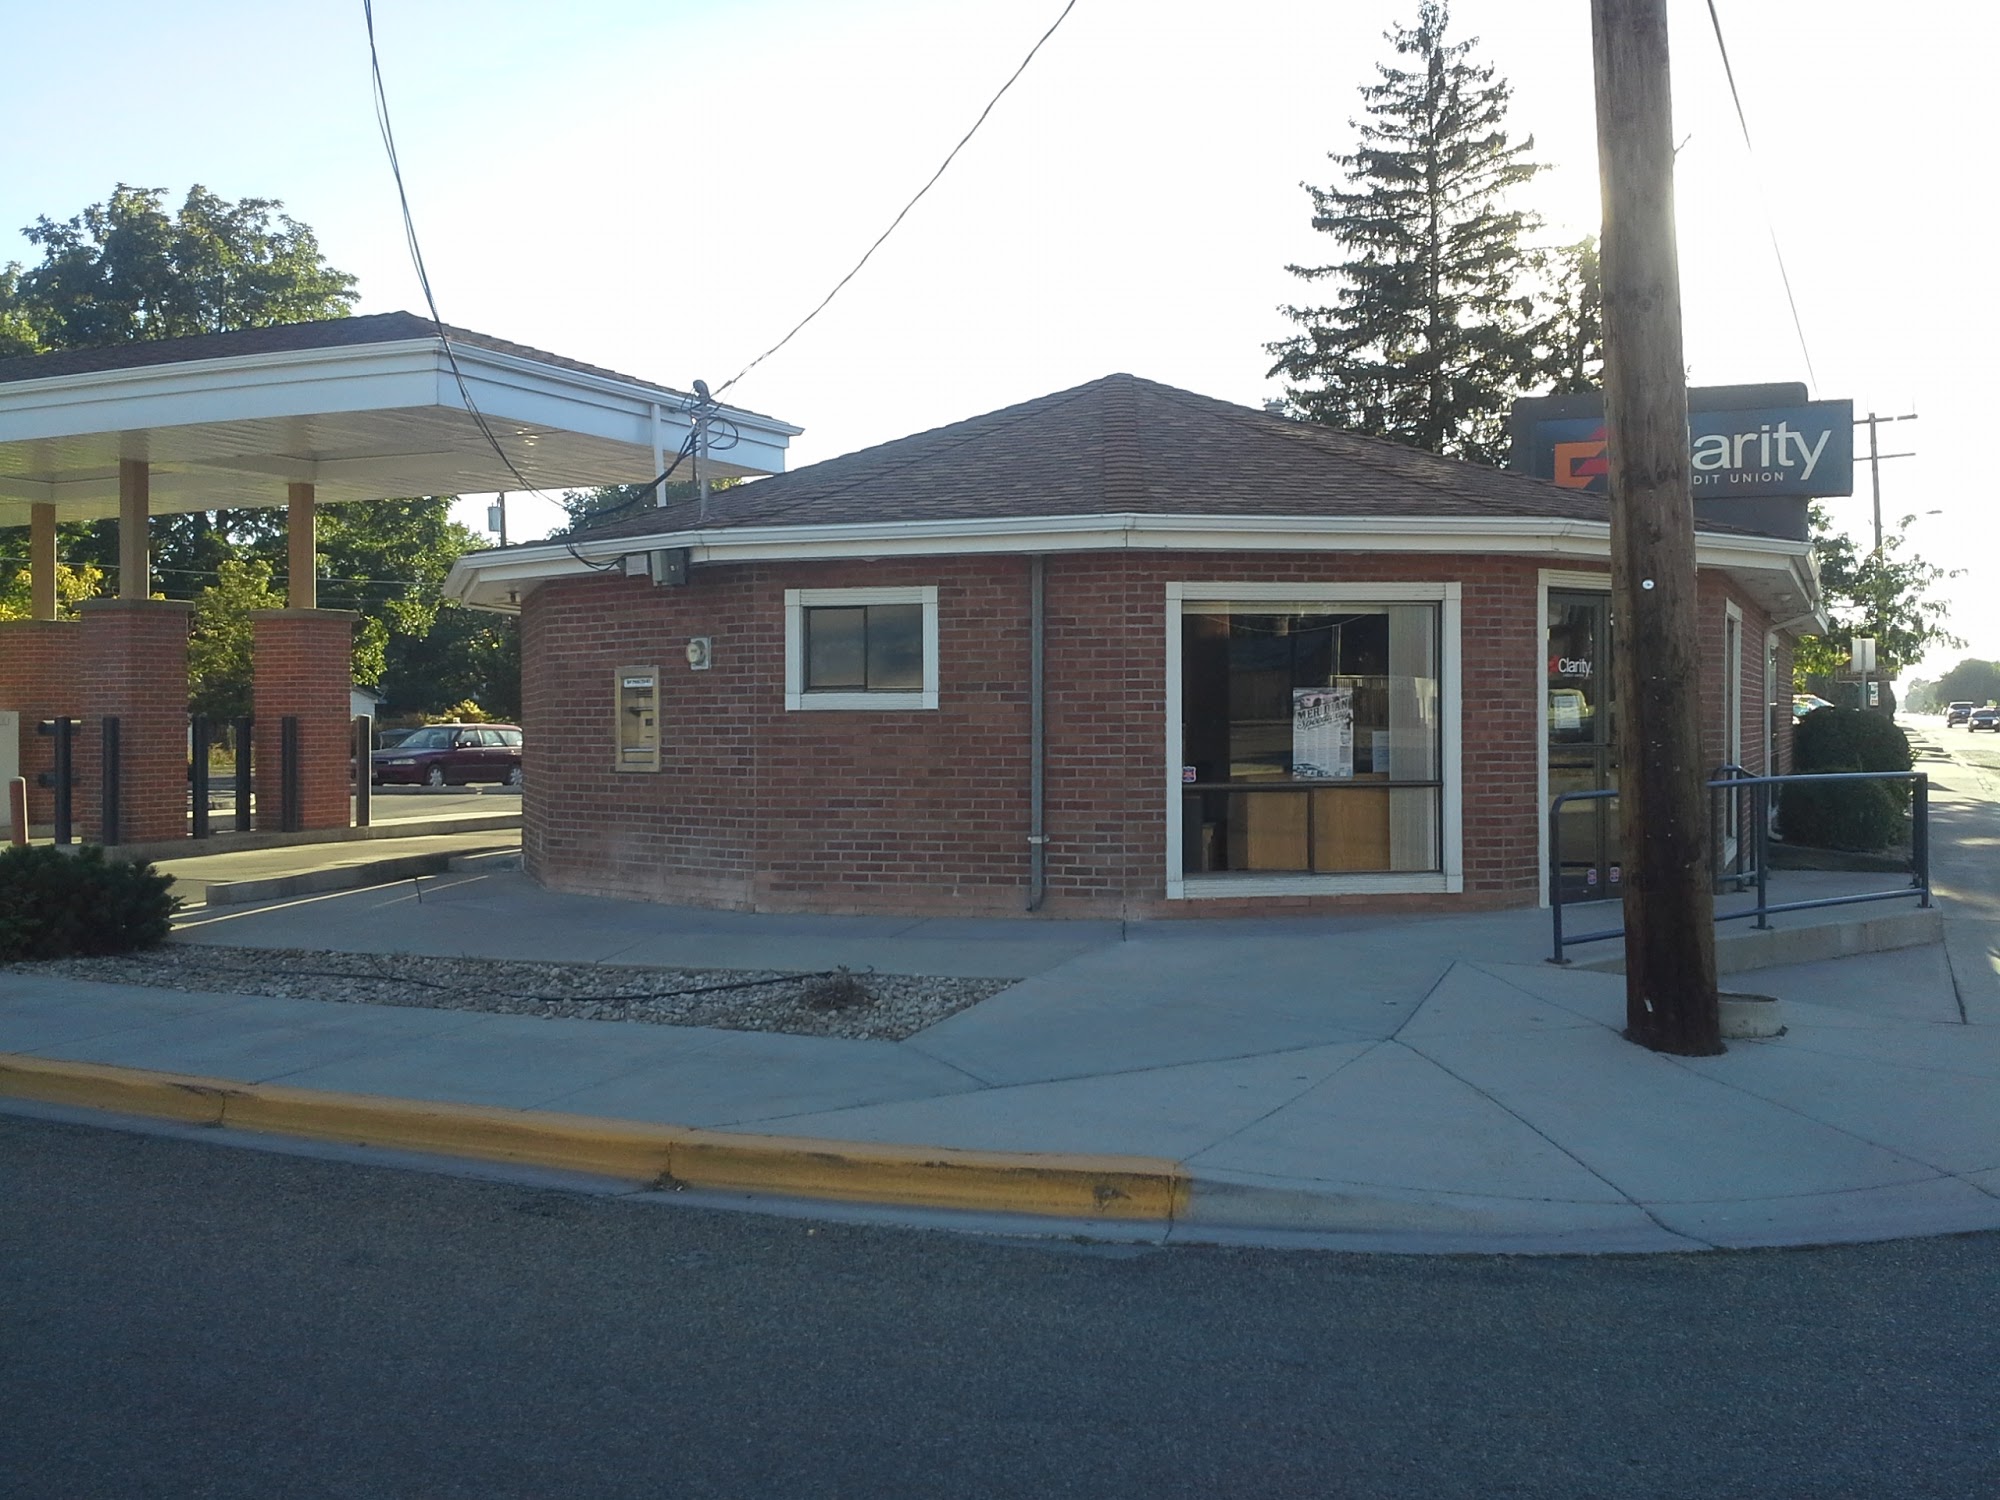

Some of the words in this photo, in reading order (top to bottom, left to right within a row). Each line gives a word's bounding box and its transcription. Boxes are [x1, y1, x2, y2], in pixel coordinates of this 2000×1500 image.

[1691, 421, 1832, 480] arity
[1693, 474, 1720, 485] DIT
[1729, 471, 1784, 483] UNION
[1558, 657, 1592, 678] Clarity
